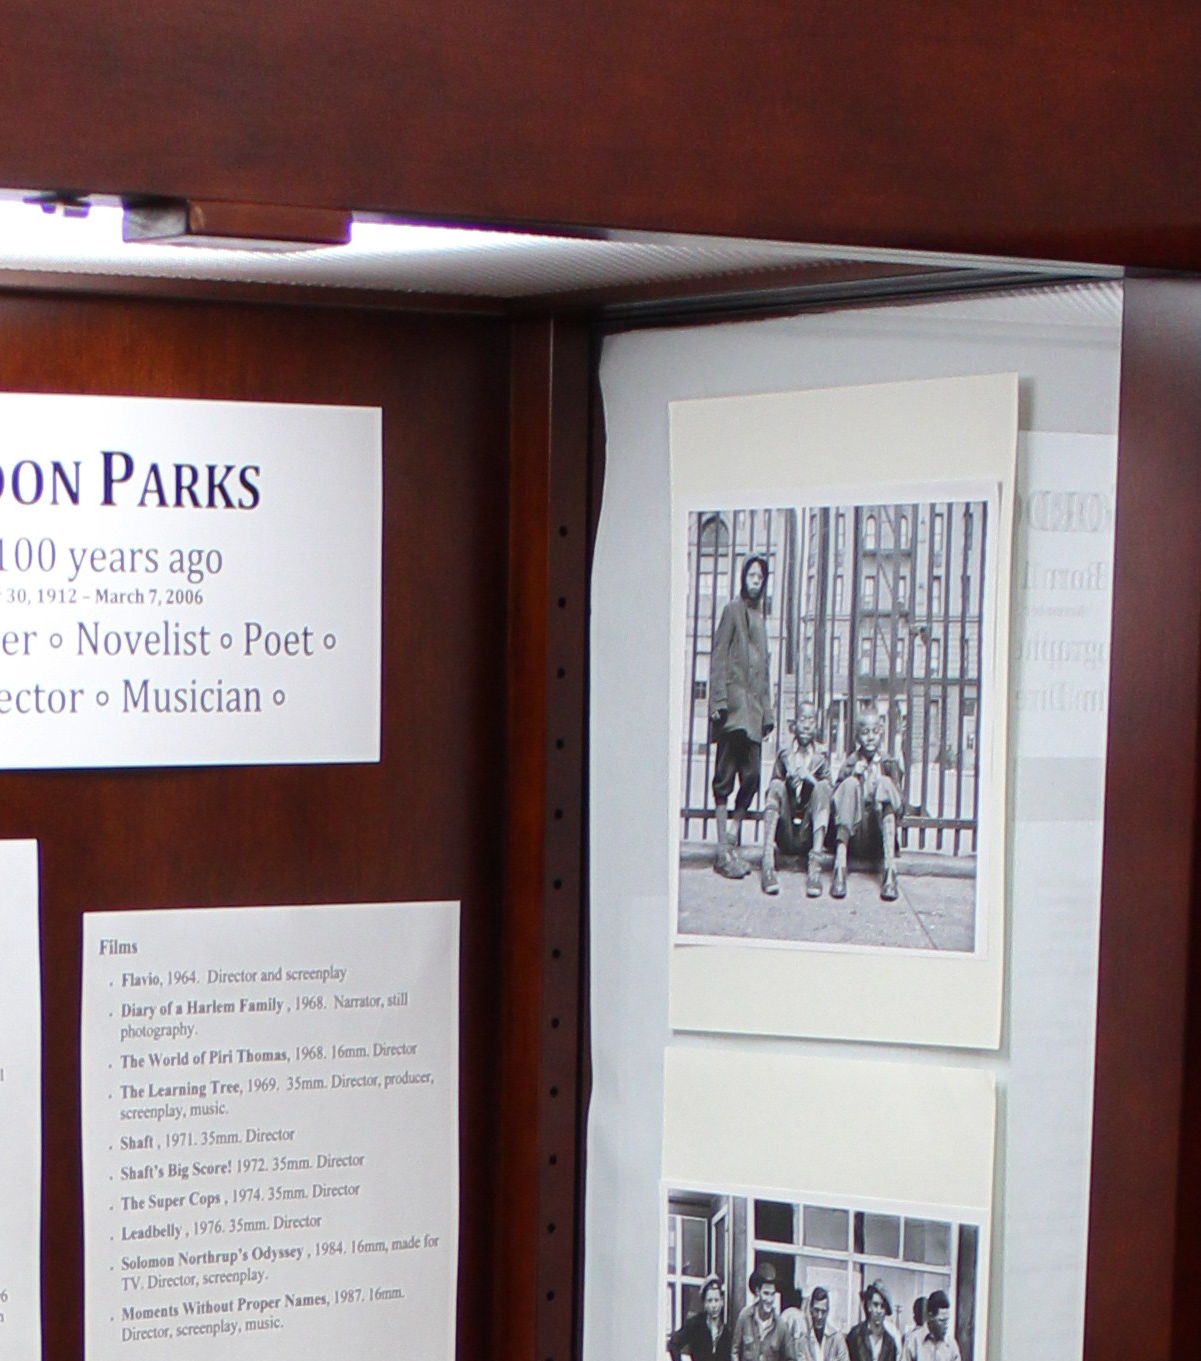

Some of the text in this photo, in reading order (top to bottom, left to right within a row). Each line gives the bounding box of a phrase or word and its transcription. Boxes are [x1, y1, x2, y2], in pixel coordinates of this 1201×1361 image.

[101, 451, 260, 510] PARKS
[68, 548, 158, 582] years
[169, 549, 222, 584] ago
[7, 589, 30, 605] 30,
[39, 589, 76, 603] 1912
[96, 588, 144, 604] March
[149, 589, 161, 606] 7,
[166, 589, 203, 605] 2006
[78, 620, 210, 656] Novelist
[245, 622, 313, 656] Poet
[123, 679, 262, 713] Musician
[99, 939, 137, 955] Films
[207, 968, 257, 983] Director
[260, 966, 281, 982] and
[286, 964, 346, 983] screenplay
[121, 1002, 156, 1019] Diary
[159, 1001, 173, 1015] of
[175, 1004, 182, 1015] a
[187, 999, 234, 1014] Harlem
[239, 997, 283, 1014] Family
[387, 992, 407, 1006] still
[120, 1054, 144, 1068] The
[148, 1051, 189, 1066] World
[193, 1050, 206, 1064] of
[209, 1049, 232, 1064] Piri
[373, 1042, 417, 1056] Director
[119, 1085, 144, 1099] The
[148, 1081, 206, 1098] Learning
[121, 1164, 164, 1180] Shaft's
[168, 1163, 189, 1179] Big
[192, 1159, 231, 1175] Score!
[316, 1153, 364, 1168] Director
[121, 1255, 174, 1270] Solomon
[251, 1246, 303, 1262] Odyssey
[391, 1235, 420, 1250] made
[424, 1234, 439, 1247] for
